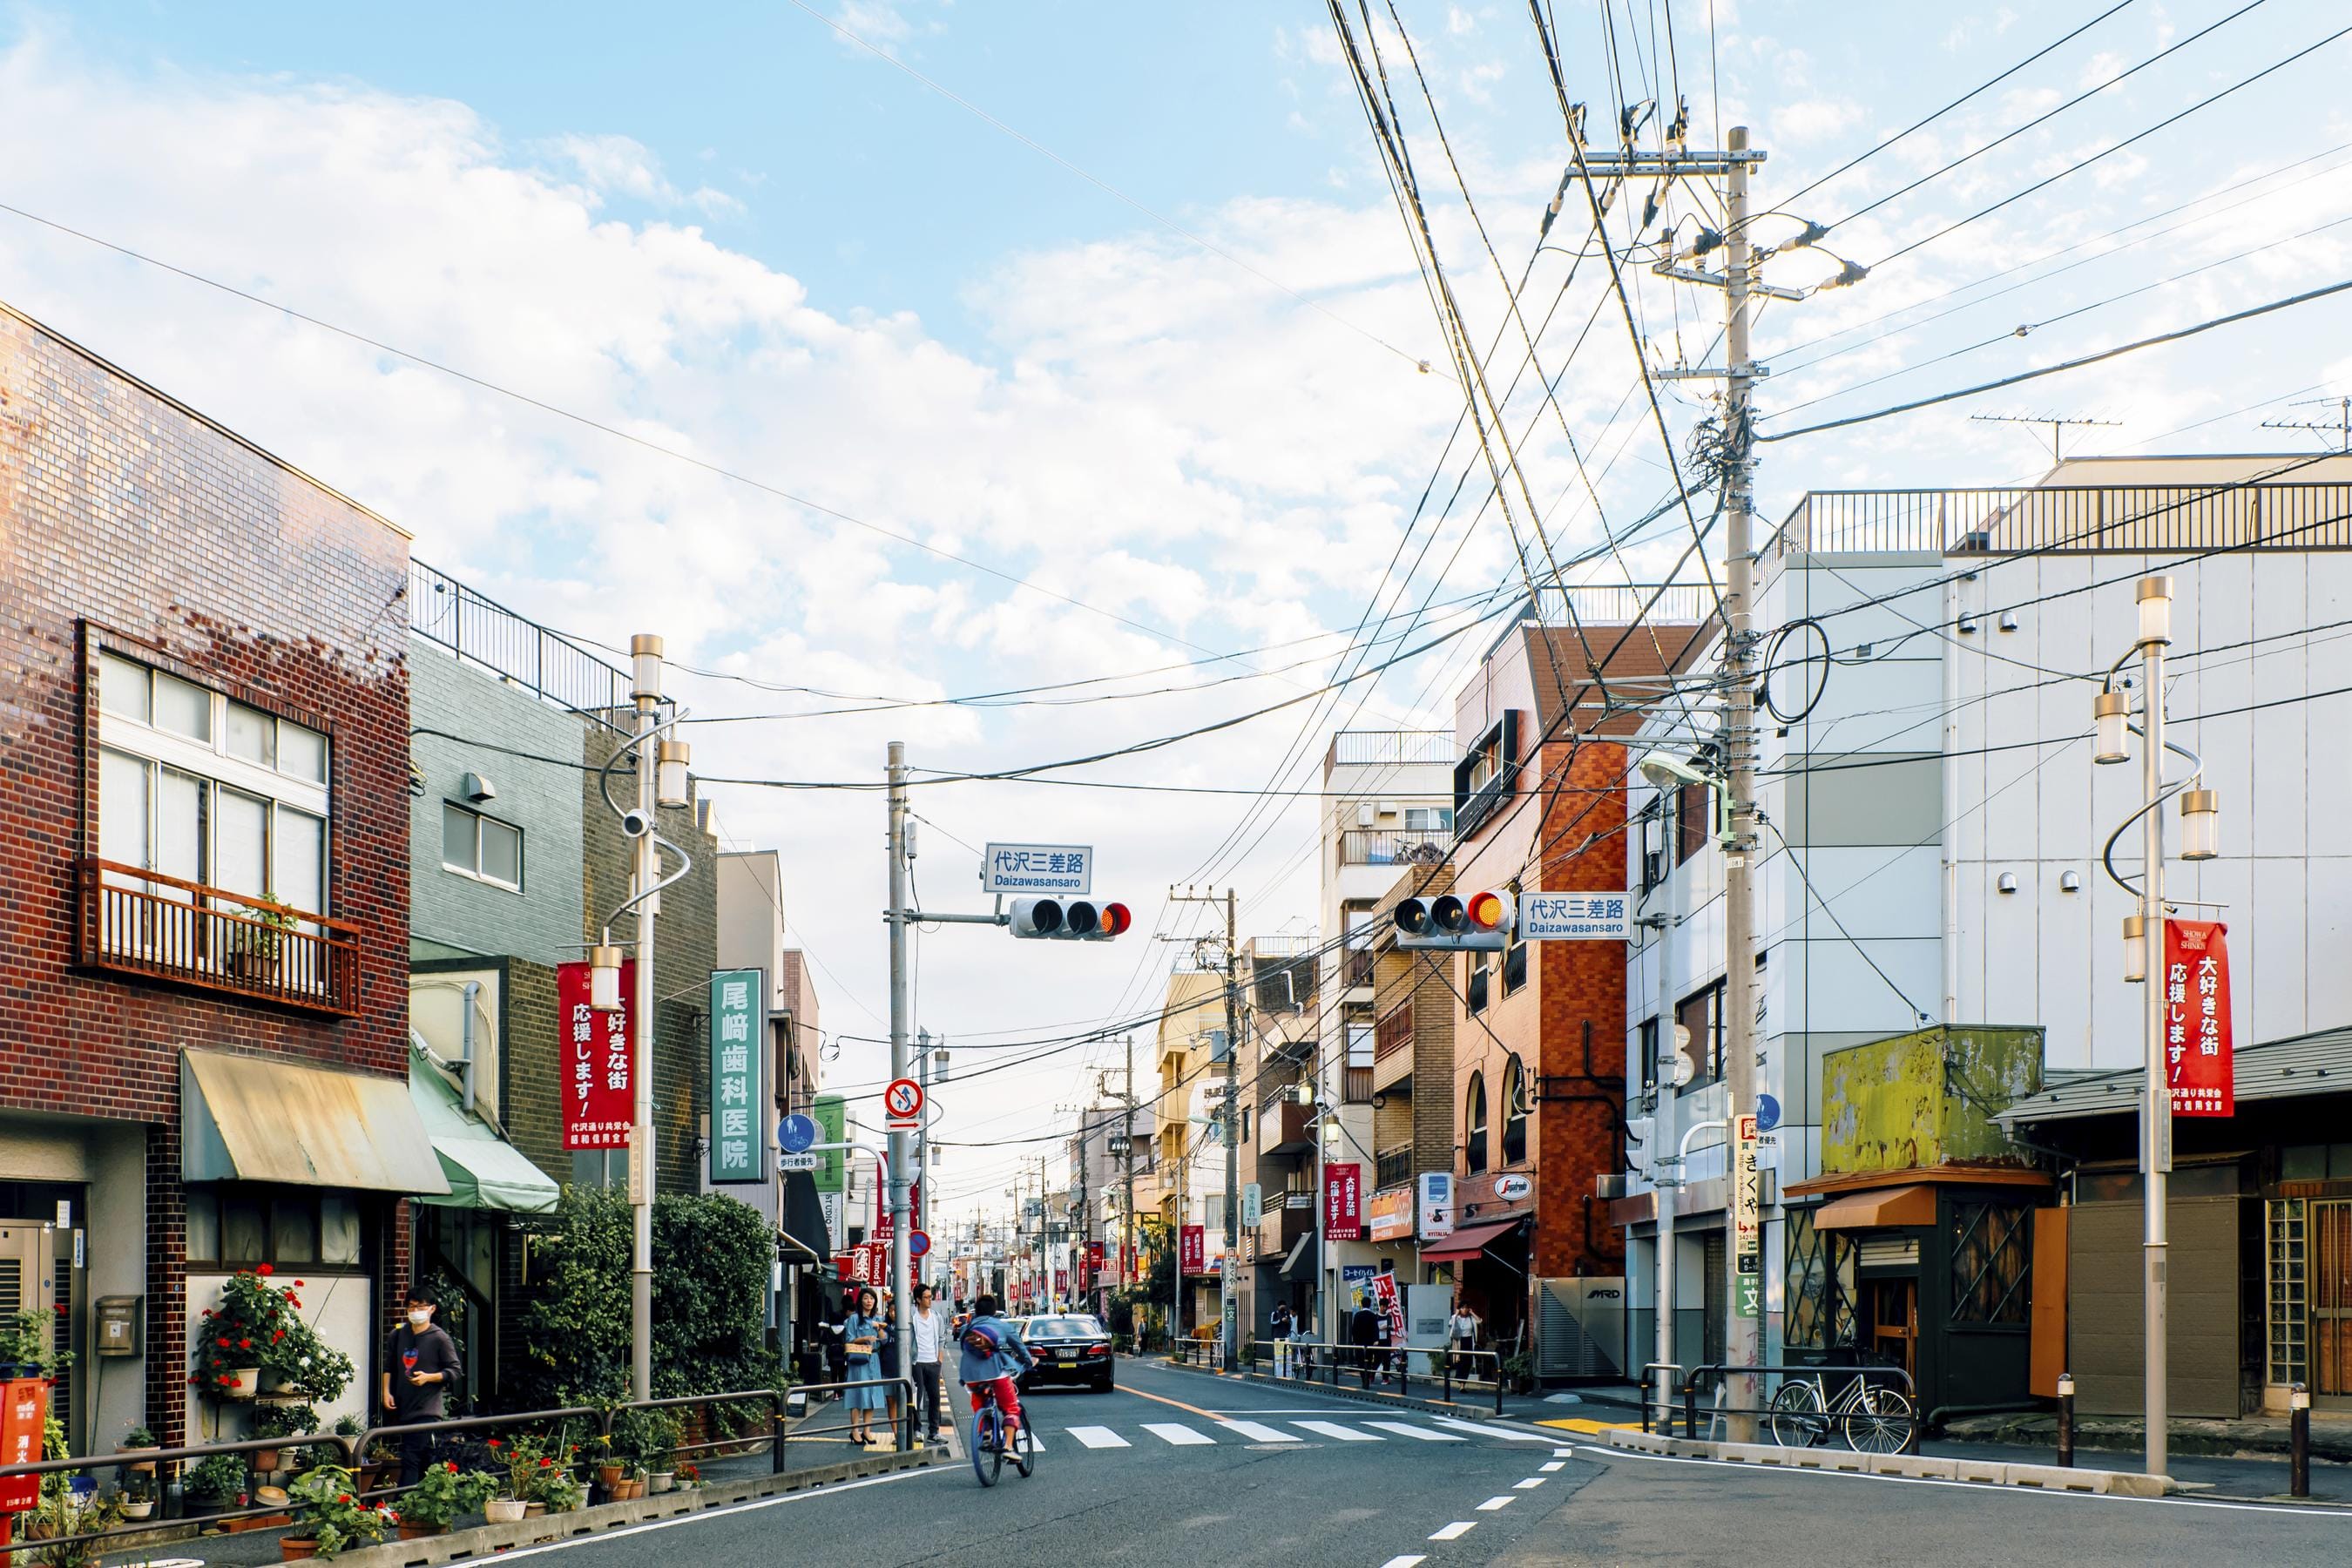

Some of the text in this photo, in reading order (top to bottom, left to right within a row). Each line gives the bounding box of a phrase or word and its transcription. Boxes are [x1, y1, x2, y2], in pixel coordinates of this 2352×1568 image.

[995, 850, 1084, 874] 代沢三差路
[995, 875, 1080, 888] Daizawasansaro
[1530, 899, 1624, 919] 代沢三差路
[1530, 923, 1623, 933] Daizawasansaro
[2199, 956, 2219, 1056] 大好きな街
[2168, 963, 2187, 1083] 応援します！
[572, 1004, 593, 1118] 応援します！
[2172, 1088, 2222, 1098] 沢通り共栄会
[2173, 1100, 2222, 1111] 和信用金庫
[781, 1158, 814, 1167] 歩行者優先
[1745, 1154, 1757, 1214] きくや
[1346, 1177, 1355, 1217] 大好きな街
[873, 1254, 882, 1286] Tomod's
[1105, 1260, 1116, 1271] 酒
